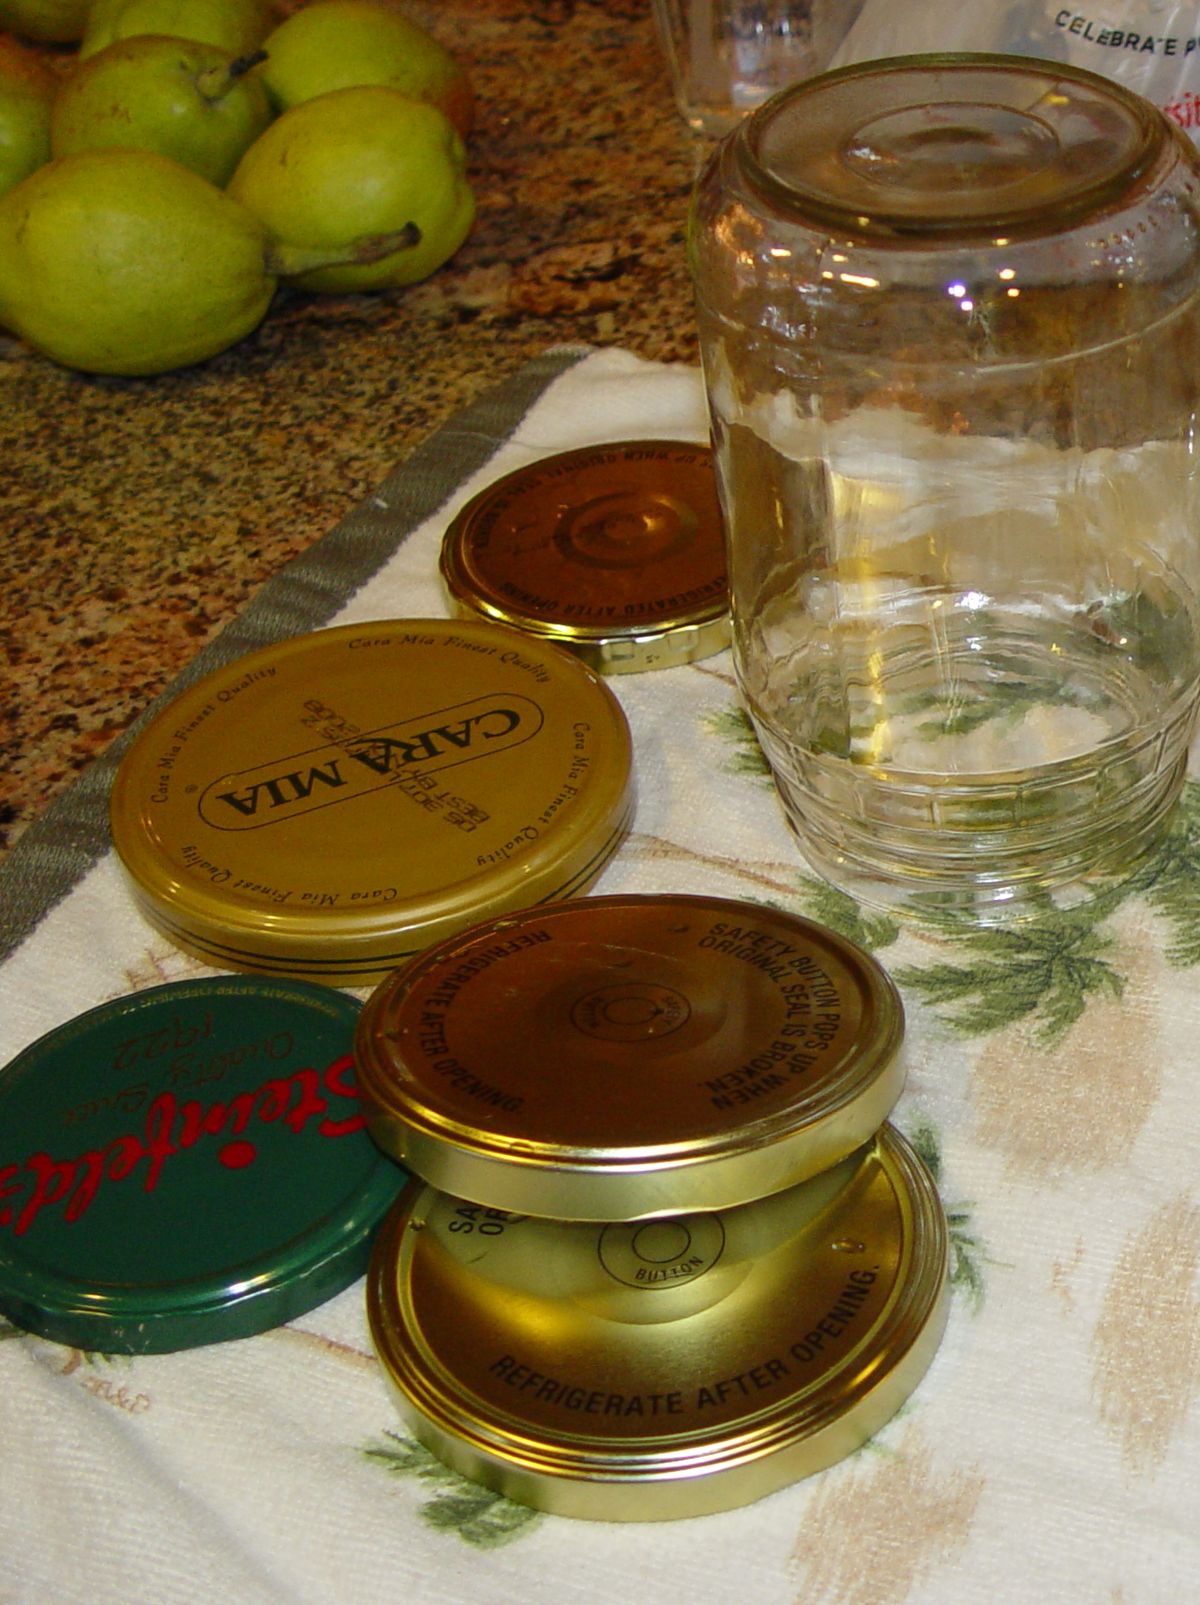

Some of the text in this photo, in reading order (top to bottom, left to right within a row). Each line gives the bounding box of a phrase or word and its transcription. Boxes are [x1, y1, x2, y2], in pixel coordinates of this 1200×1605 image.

[1054, 9, 1177, 57] CELEBRATE
[563, 604, 616, 617] AFTER
[348, 633, 552, 684] Cara Mia Finest Quality
[150, 666, 278, 804] Cara Mia Finest Quality
[345, 707, 522, 776] CARA
[214, 758, 349, 818] MIA
[433, 790, 491, 825] BEST
[476, 722, 592, 867] Cara Mia Finest Quality
[181, 844, 398, 906] Cara Mia Finest Quality
[698, 935, 793, 984] ORIGINAL
[709, 922, 798, 957] SAFETY
[424, 929, 553, 1011] REFRIGERATE
[790, 956, 841, 1009] BUTTON
[781, 983, 811, 1020] SEAL
[110, 1010, 214, 1072] 1922
[418, 1013, 449, 1058] AFTER
[781, 1023, 806, 1038] IS
[803, 1013, 840, 1051] POPS
[788, 1052, 819, 1075] UP
[634, 1256, 704, 1283] BUTTON
[489, 1353, 685, 1417] REFRIGERATE
[696, 1360, 791, 1411] AFTER
